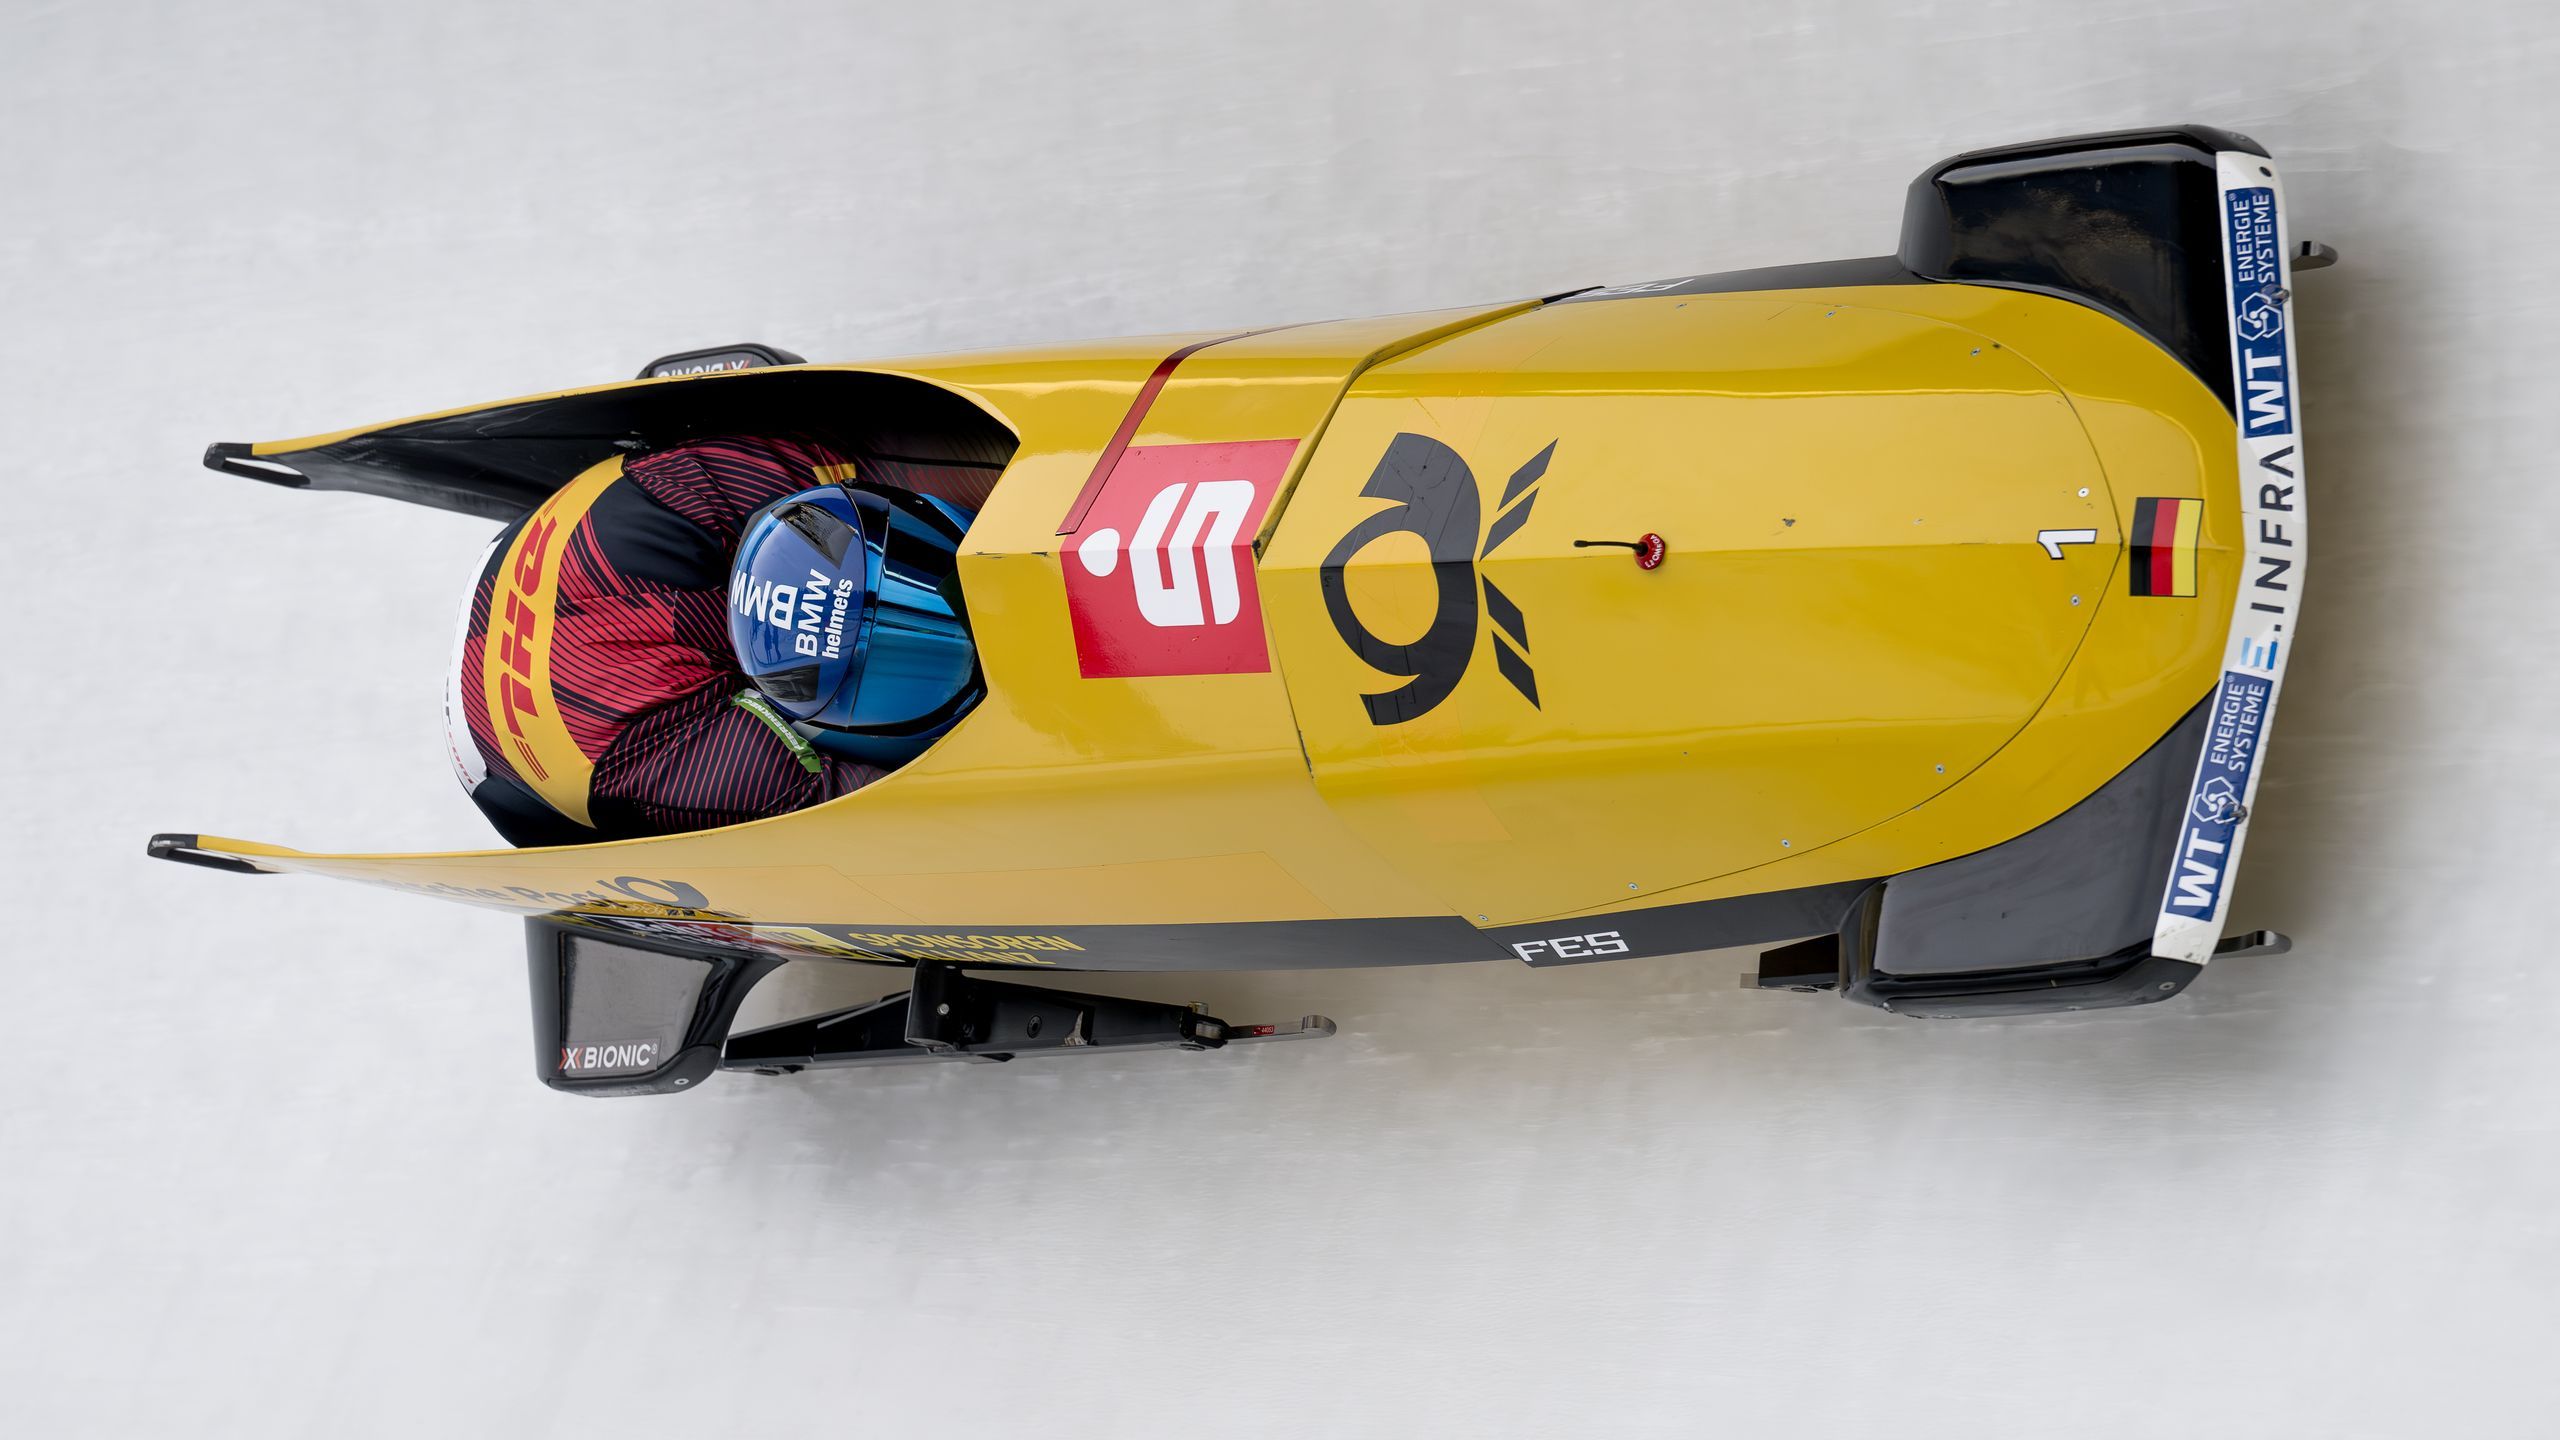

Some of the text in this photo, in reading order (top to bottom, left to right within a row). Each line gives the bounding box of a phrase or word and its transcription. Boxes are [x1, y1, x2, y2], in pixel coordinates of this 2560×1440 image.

[2253, 194, 2275, 284] SYSTEME
[2244, 348, 2285, 429] WT
[2036, 528, 2098, 560] 1
[500, 516, 557, 740] DHL
[730, 569, 798, 631] BMW
[795, 569, 831, 657] BMW
[822, 579, 853, 659] helmets
[2228, 683, 2266, 772] SYSTEME
[2173, 828, 2226, 908] WT
[848, 932, 1087, 951] SPONSOREN
[893, 948, 1056, 965] ALLIANZ
[1511, 931, 1630, 962] FES
